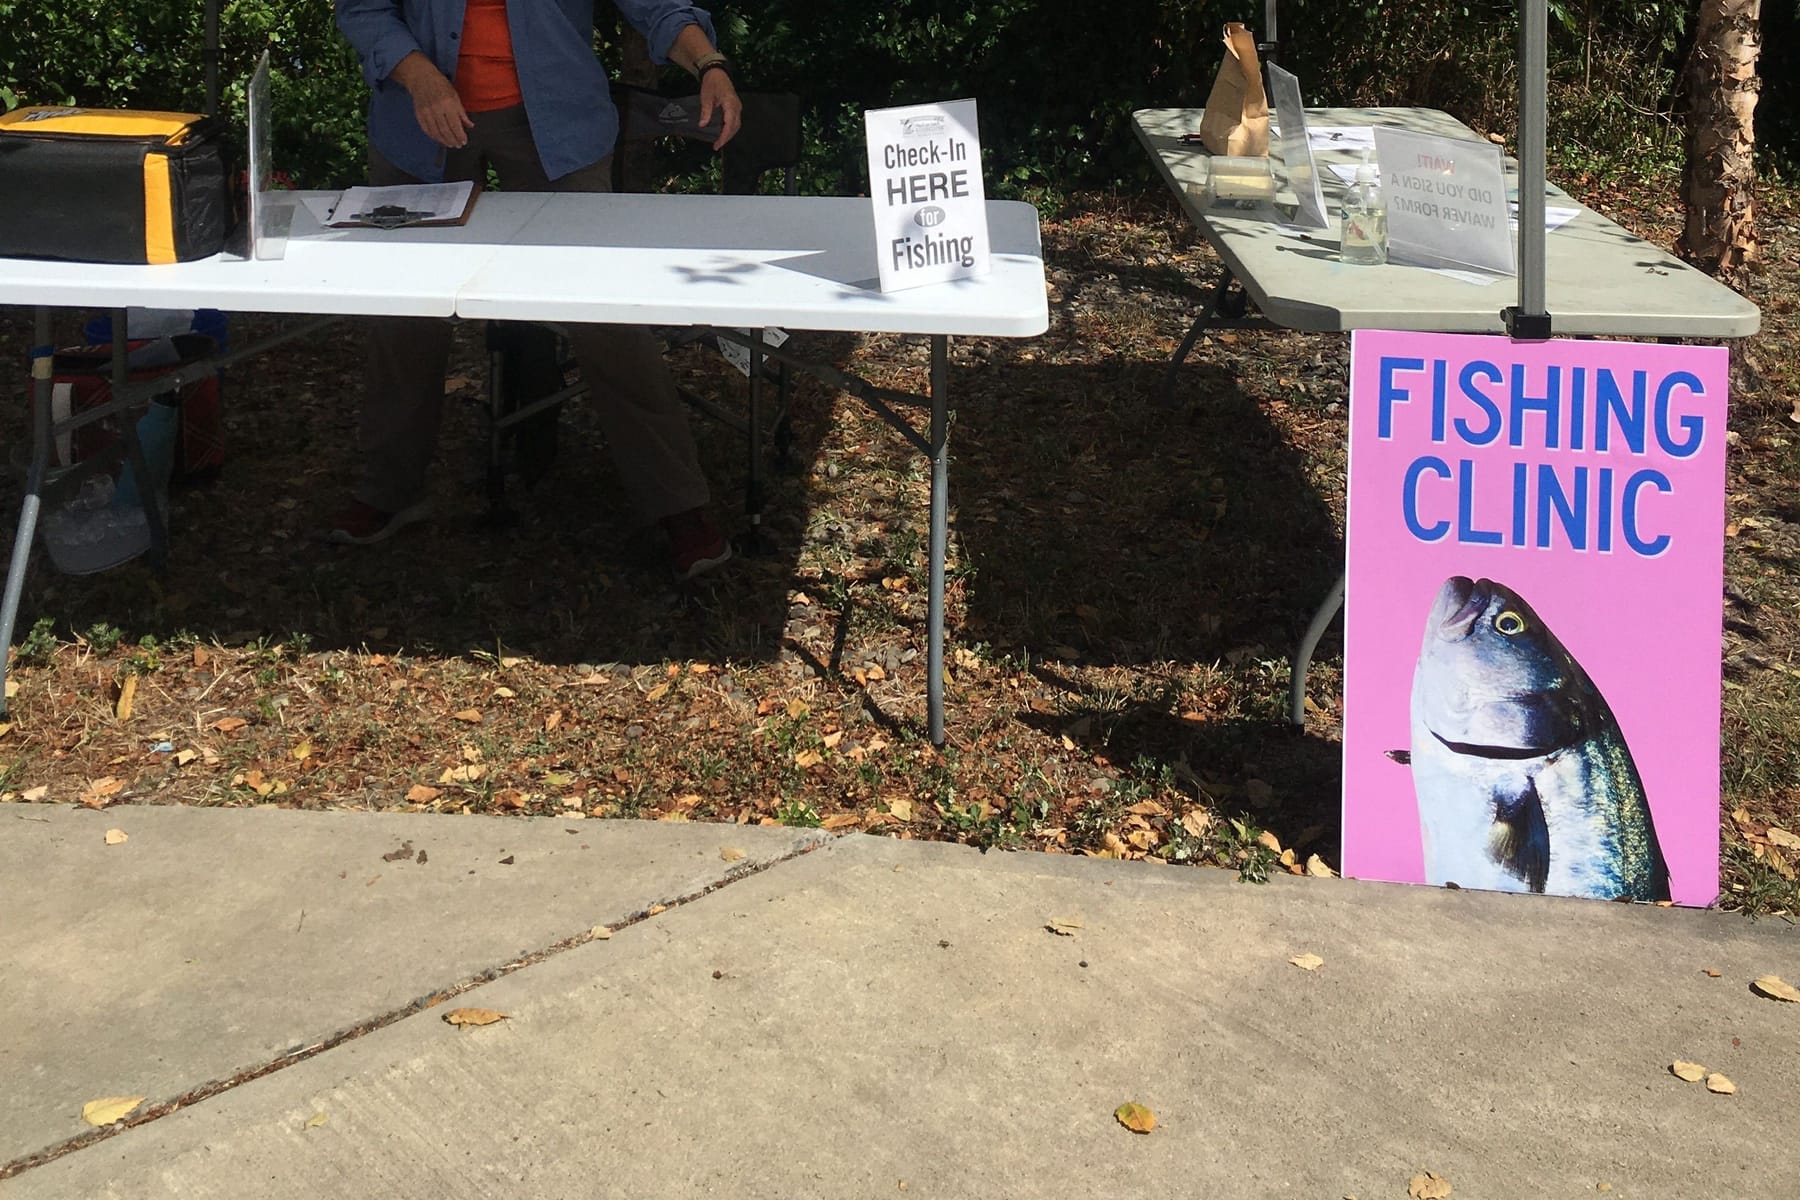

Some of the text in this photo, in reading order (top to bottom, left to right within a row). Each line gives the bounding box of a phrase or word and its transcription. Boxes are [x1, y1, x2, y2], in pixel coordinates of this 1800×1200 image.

[884, 138, 966, 170] Check-In
[886, 169, 970, 206] HERE
[919, 209, 940, 226] for
[891, 232, 976, 272] Fishing
[1377, 356, 1706, 458] FISHING
[1402, 455, 1673, 558] CLINIC
